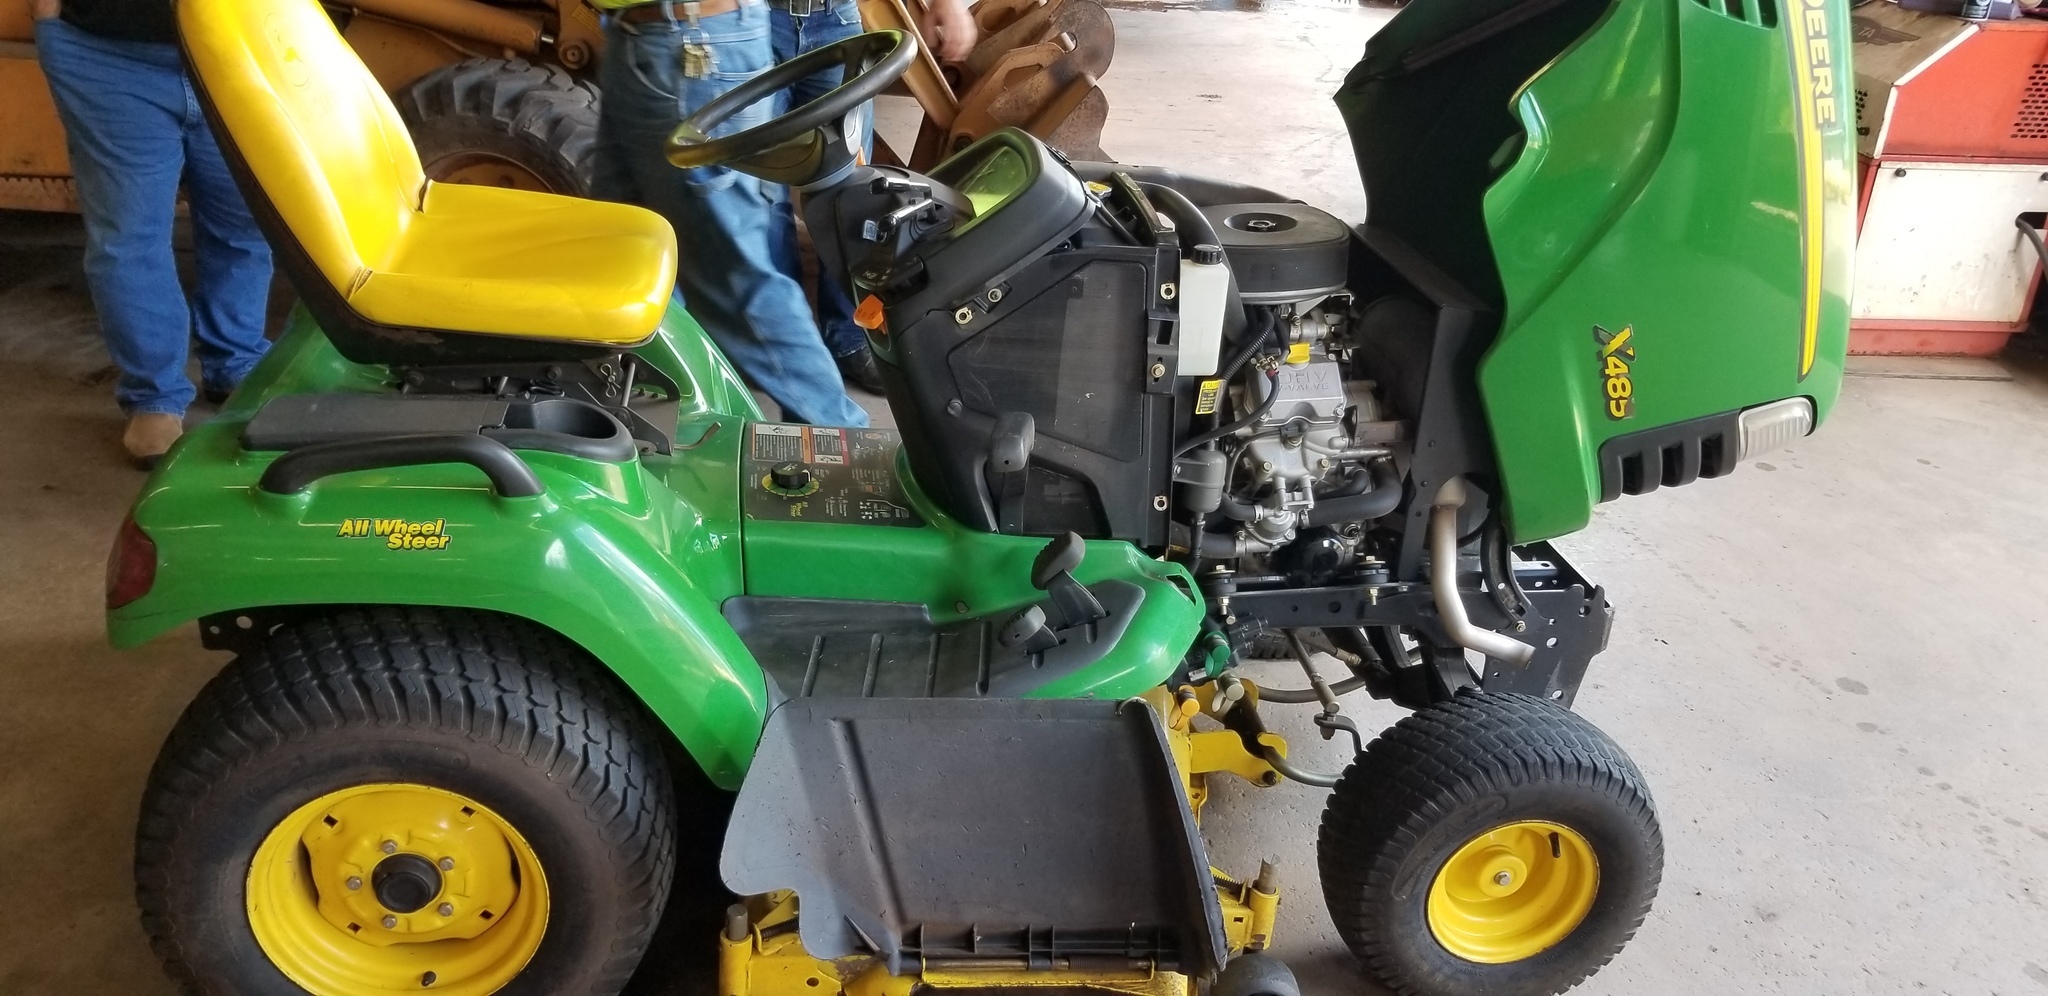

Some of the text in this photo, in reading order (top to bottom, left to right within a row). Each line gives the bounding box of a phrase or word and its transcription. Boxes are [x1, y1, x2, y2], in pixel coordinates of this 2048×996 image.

[1804, 0, 1836, 124] EERE
[338, 518, 445, 537] All Wheel
[387, 533, 450, 550] Steer
